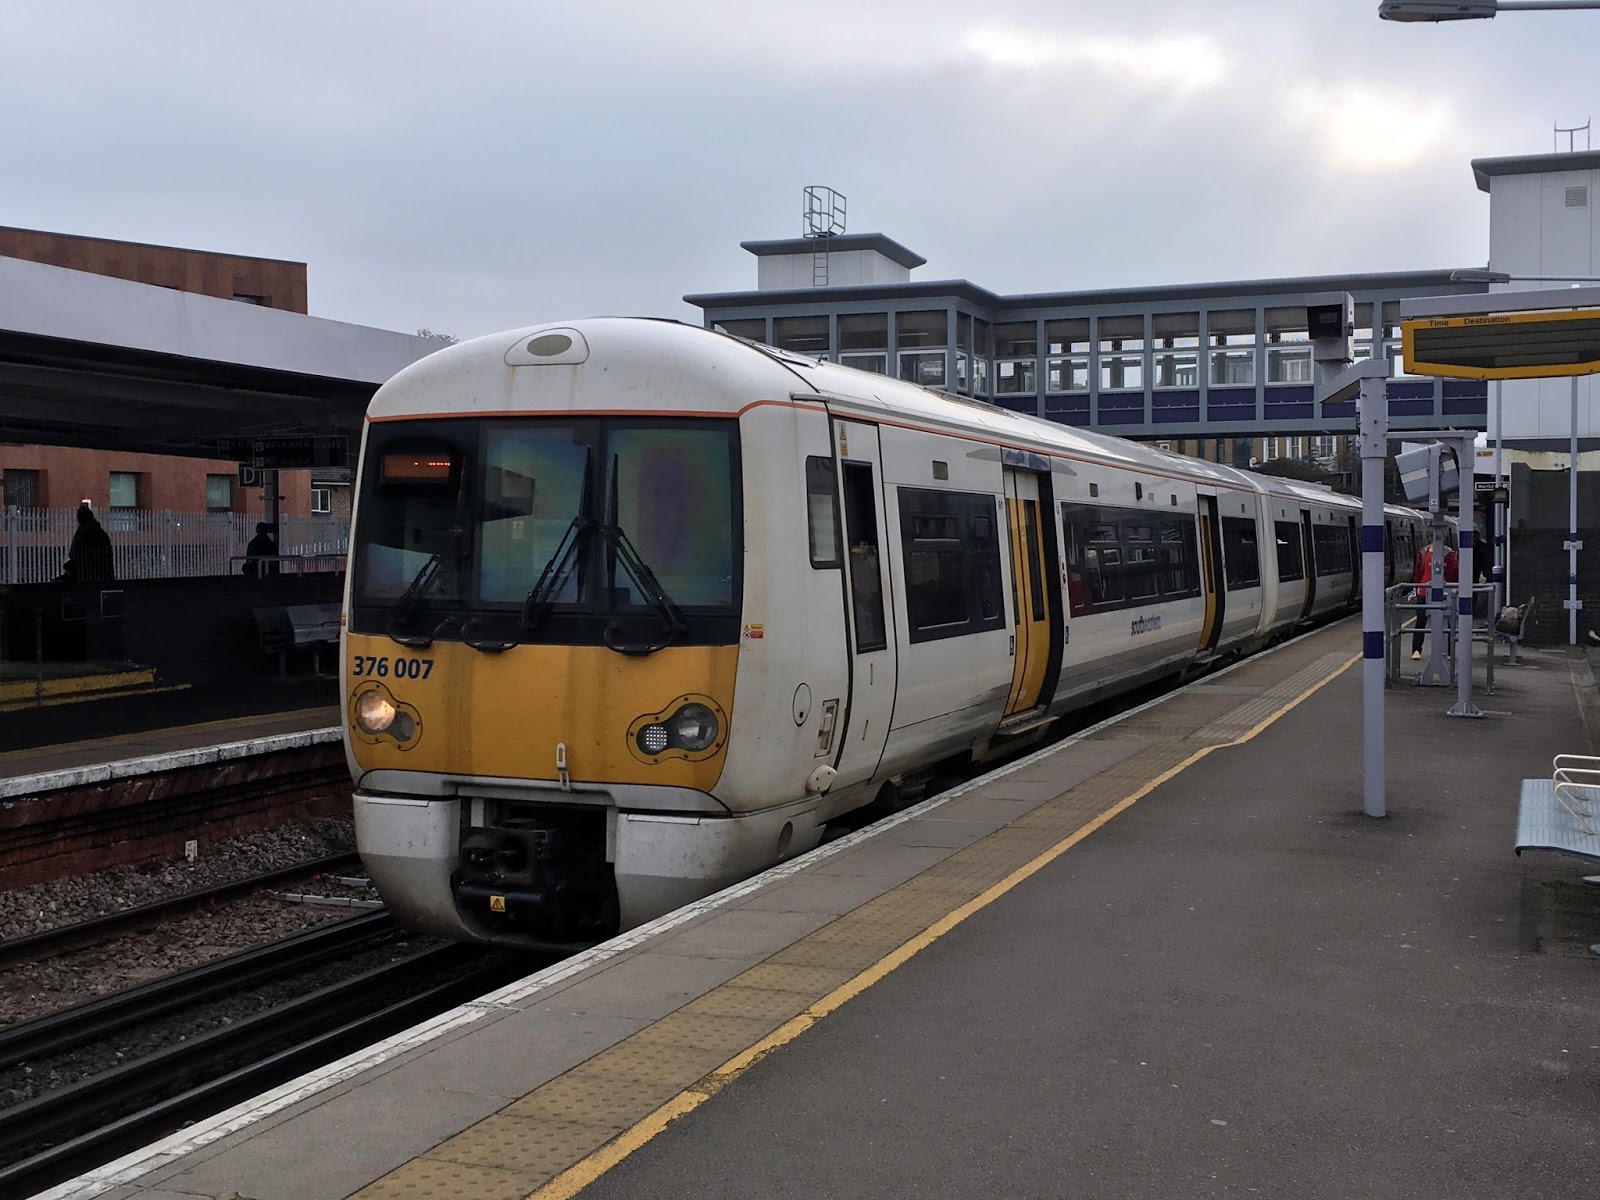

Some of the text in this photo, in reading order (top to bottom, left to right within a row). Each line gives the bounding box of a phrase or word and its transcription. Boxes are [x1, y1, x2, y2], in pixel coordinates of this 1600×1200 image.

[1464, 317, 1511, 325] Destination
[244, 467, 255, 483] D
[353, 656, 433, 679] 376 007
